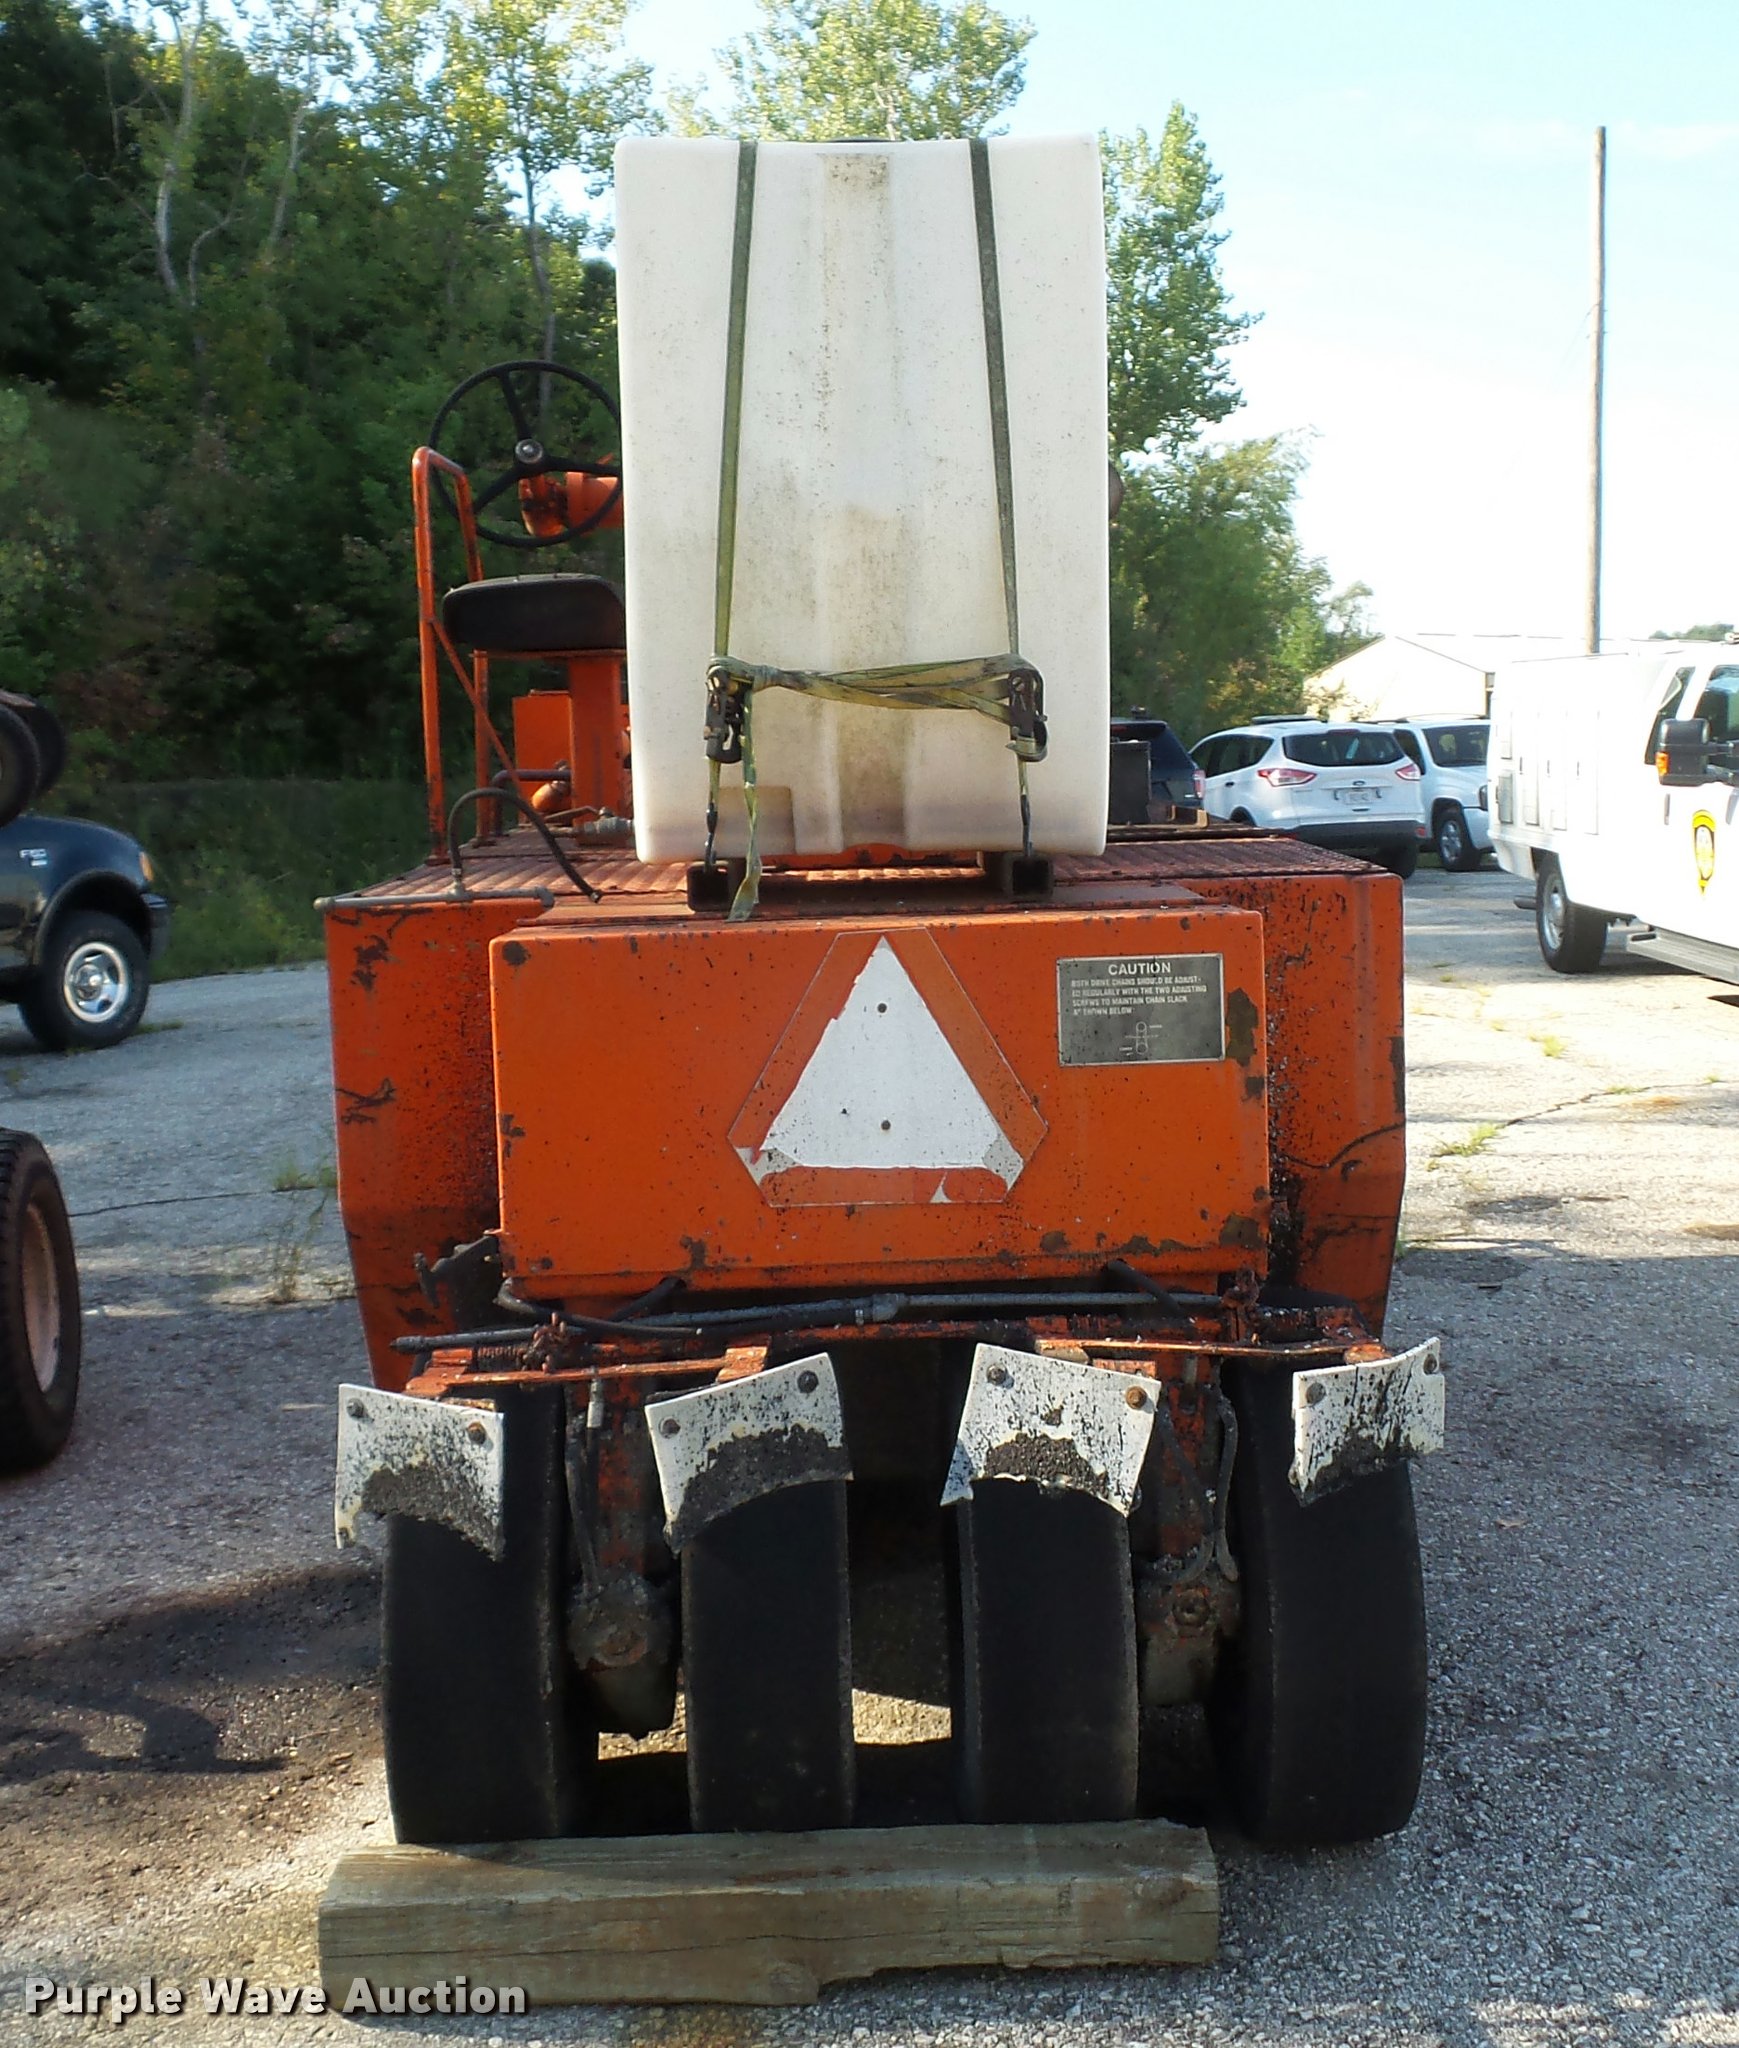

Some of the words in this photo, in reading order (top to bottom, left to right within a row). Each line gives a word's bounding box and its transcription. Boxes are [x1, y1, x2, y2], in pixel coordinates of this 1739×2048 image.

[1108, 962, 1171, 975] CAUTION
[1090, 979, 1109, 987] DRIVE
[1111, 978, 1135, 986] CHAINS
[1137, 977, 1163, 985] SHOULD
[1082, 988, 1120, 997] REGULARLY
[1122, 987, 1139, 995] WITH
[1155, 986, 1170, 994] TWO
[1172, 985, 1207, 993] ADJUSTING
[1073, 999, 1099, 1007] SCREWS
[1101, 998, 1110, 1006] TO
[1112, 997, 1144, 1005] MAINTAIN
[1145, 996, 1165, 1004] CHAIN
[1167, 995, 1188, 1003] SLACK
